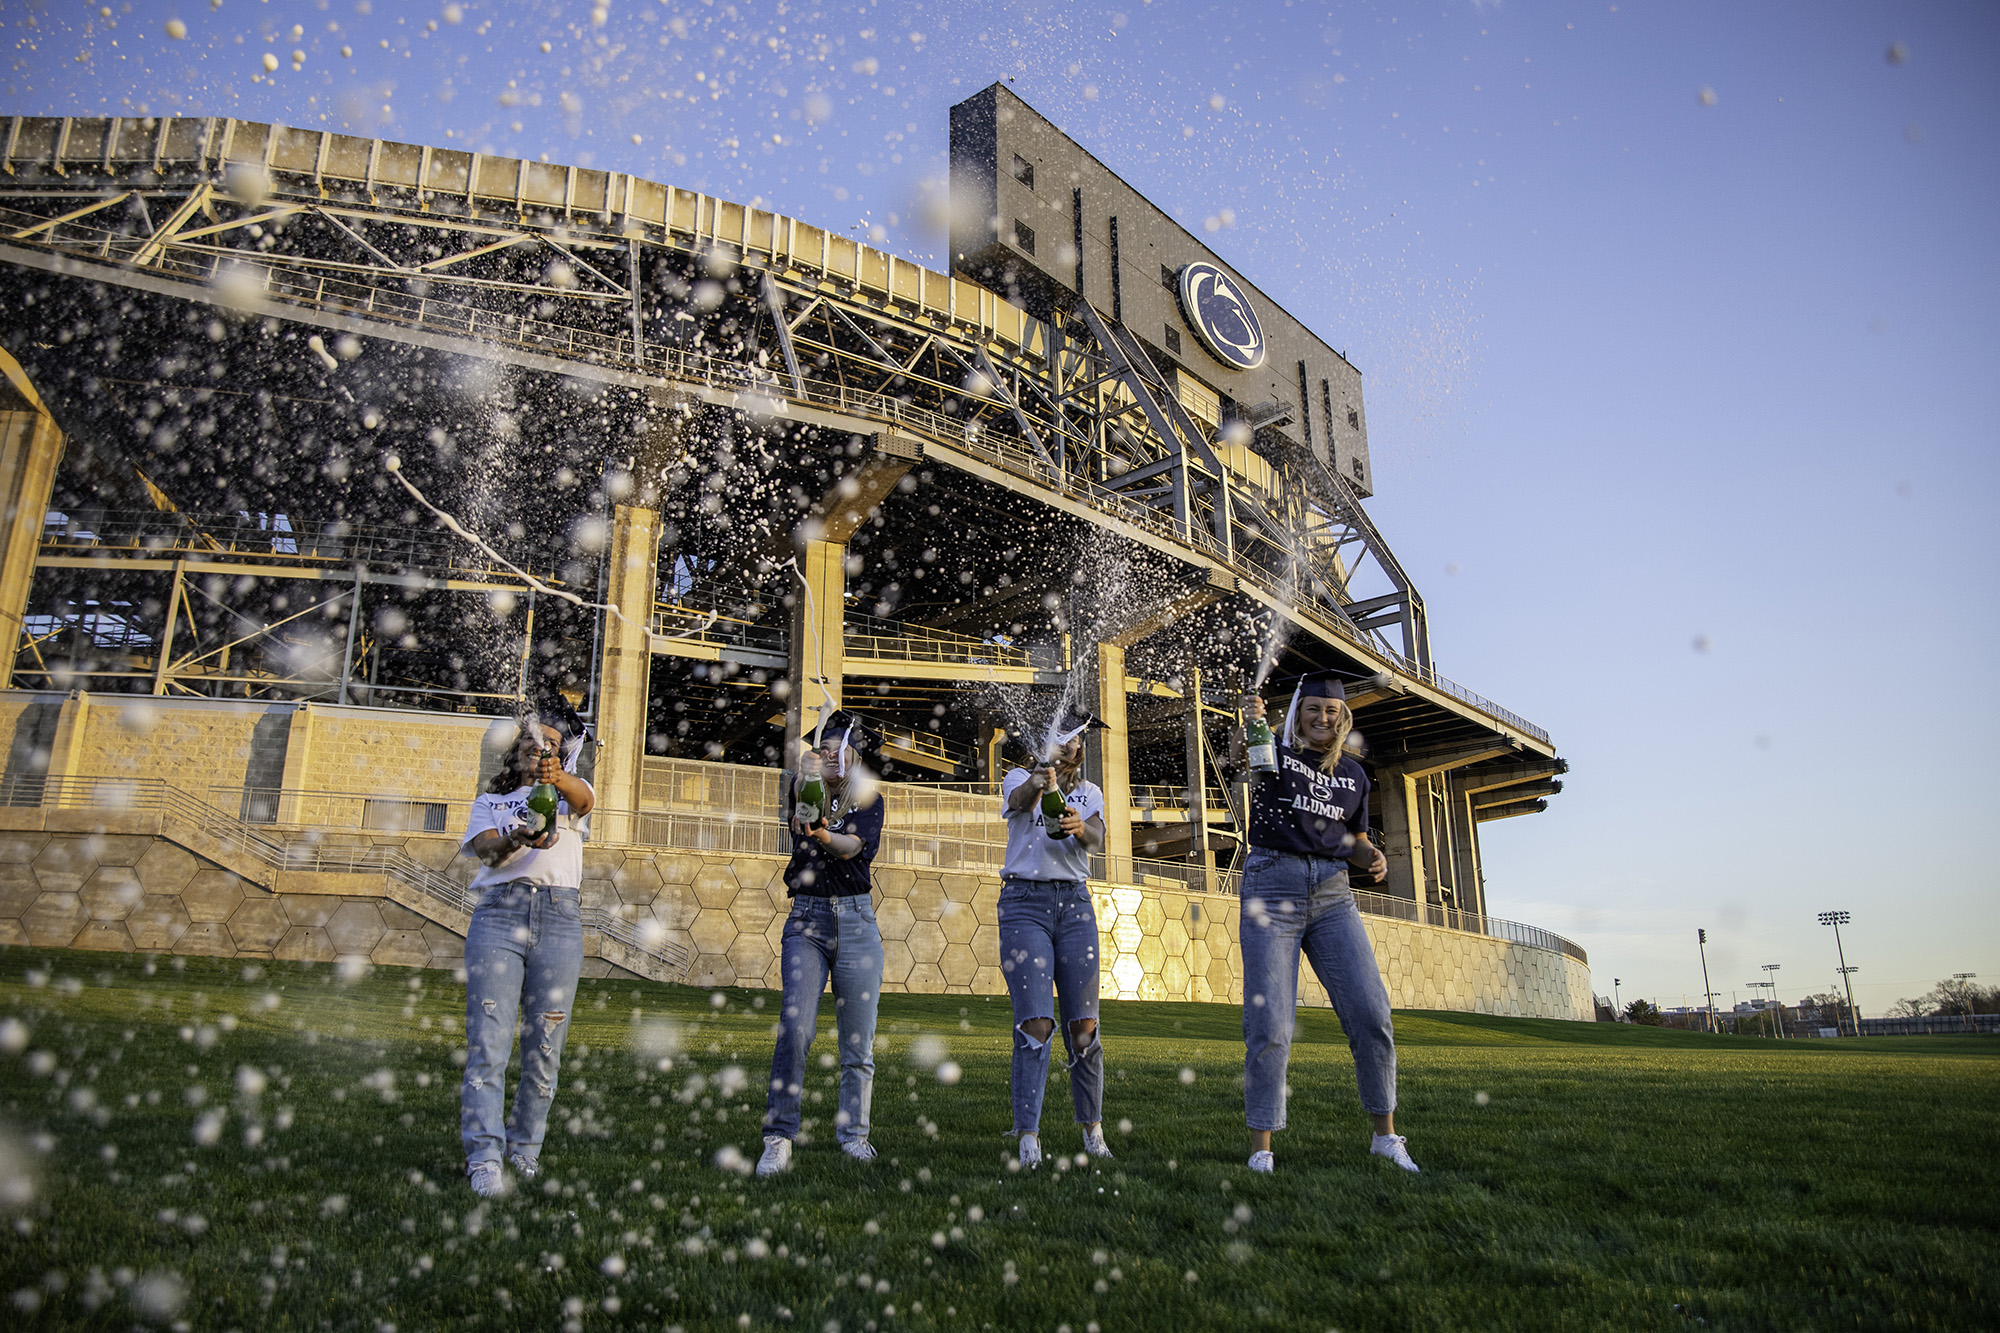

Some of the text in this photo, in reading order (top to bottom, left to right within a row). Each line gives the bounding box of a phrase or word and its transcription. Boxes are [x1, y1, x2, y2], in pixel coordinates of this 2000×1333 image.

[1282, 755, 1315, 780] PENN
[1316, 771, 1356, 792] STATE
[1067, 795, 1087, 807] ATE
[1291, 793, 1344, 820] ALUMNI
